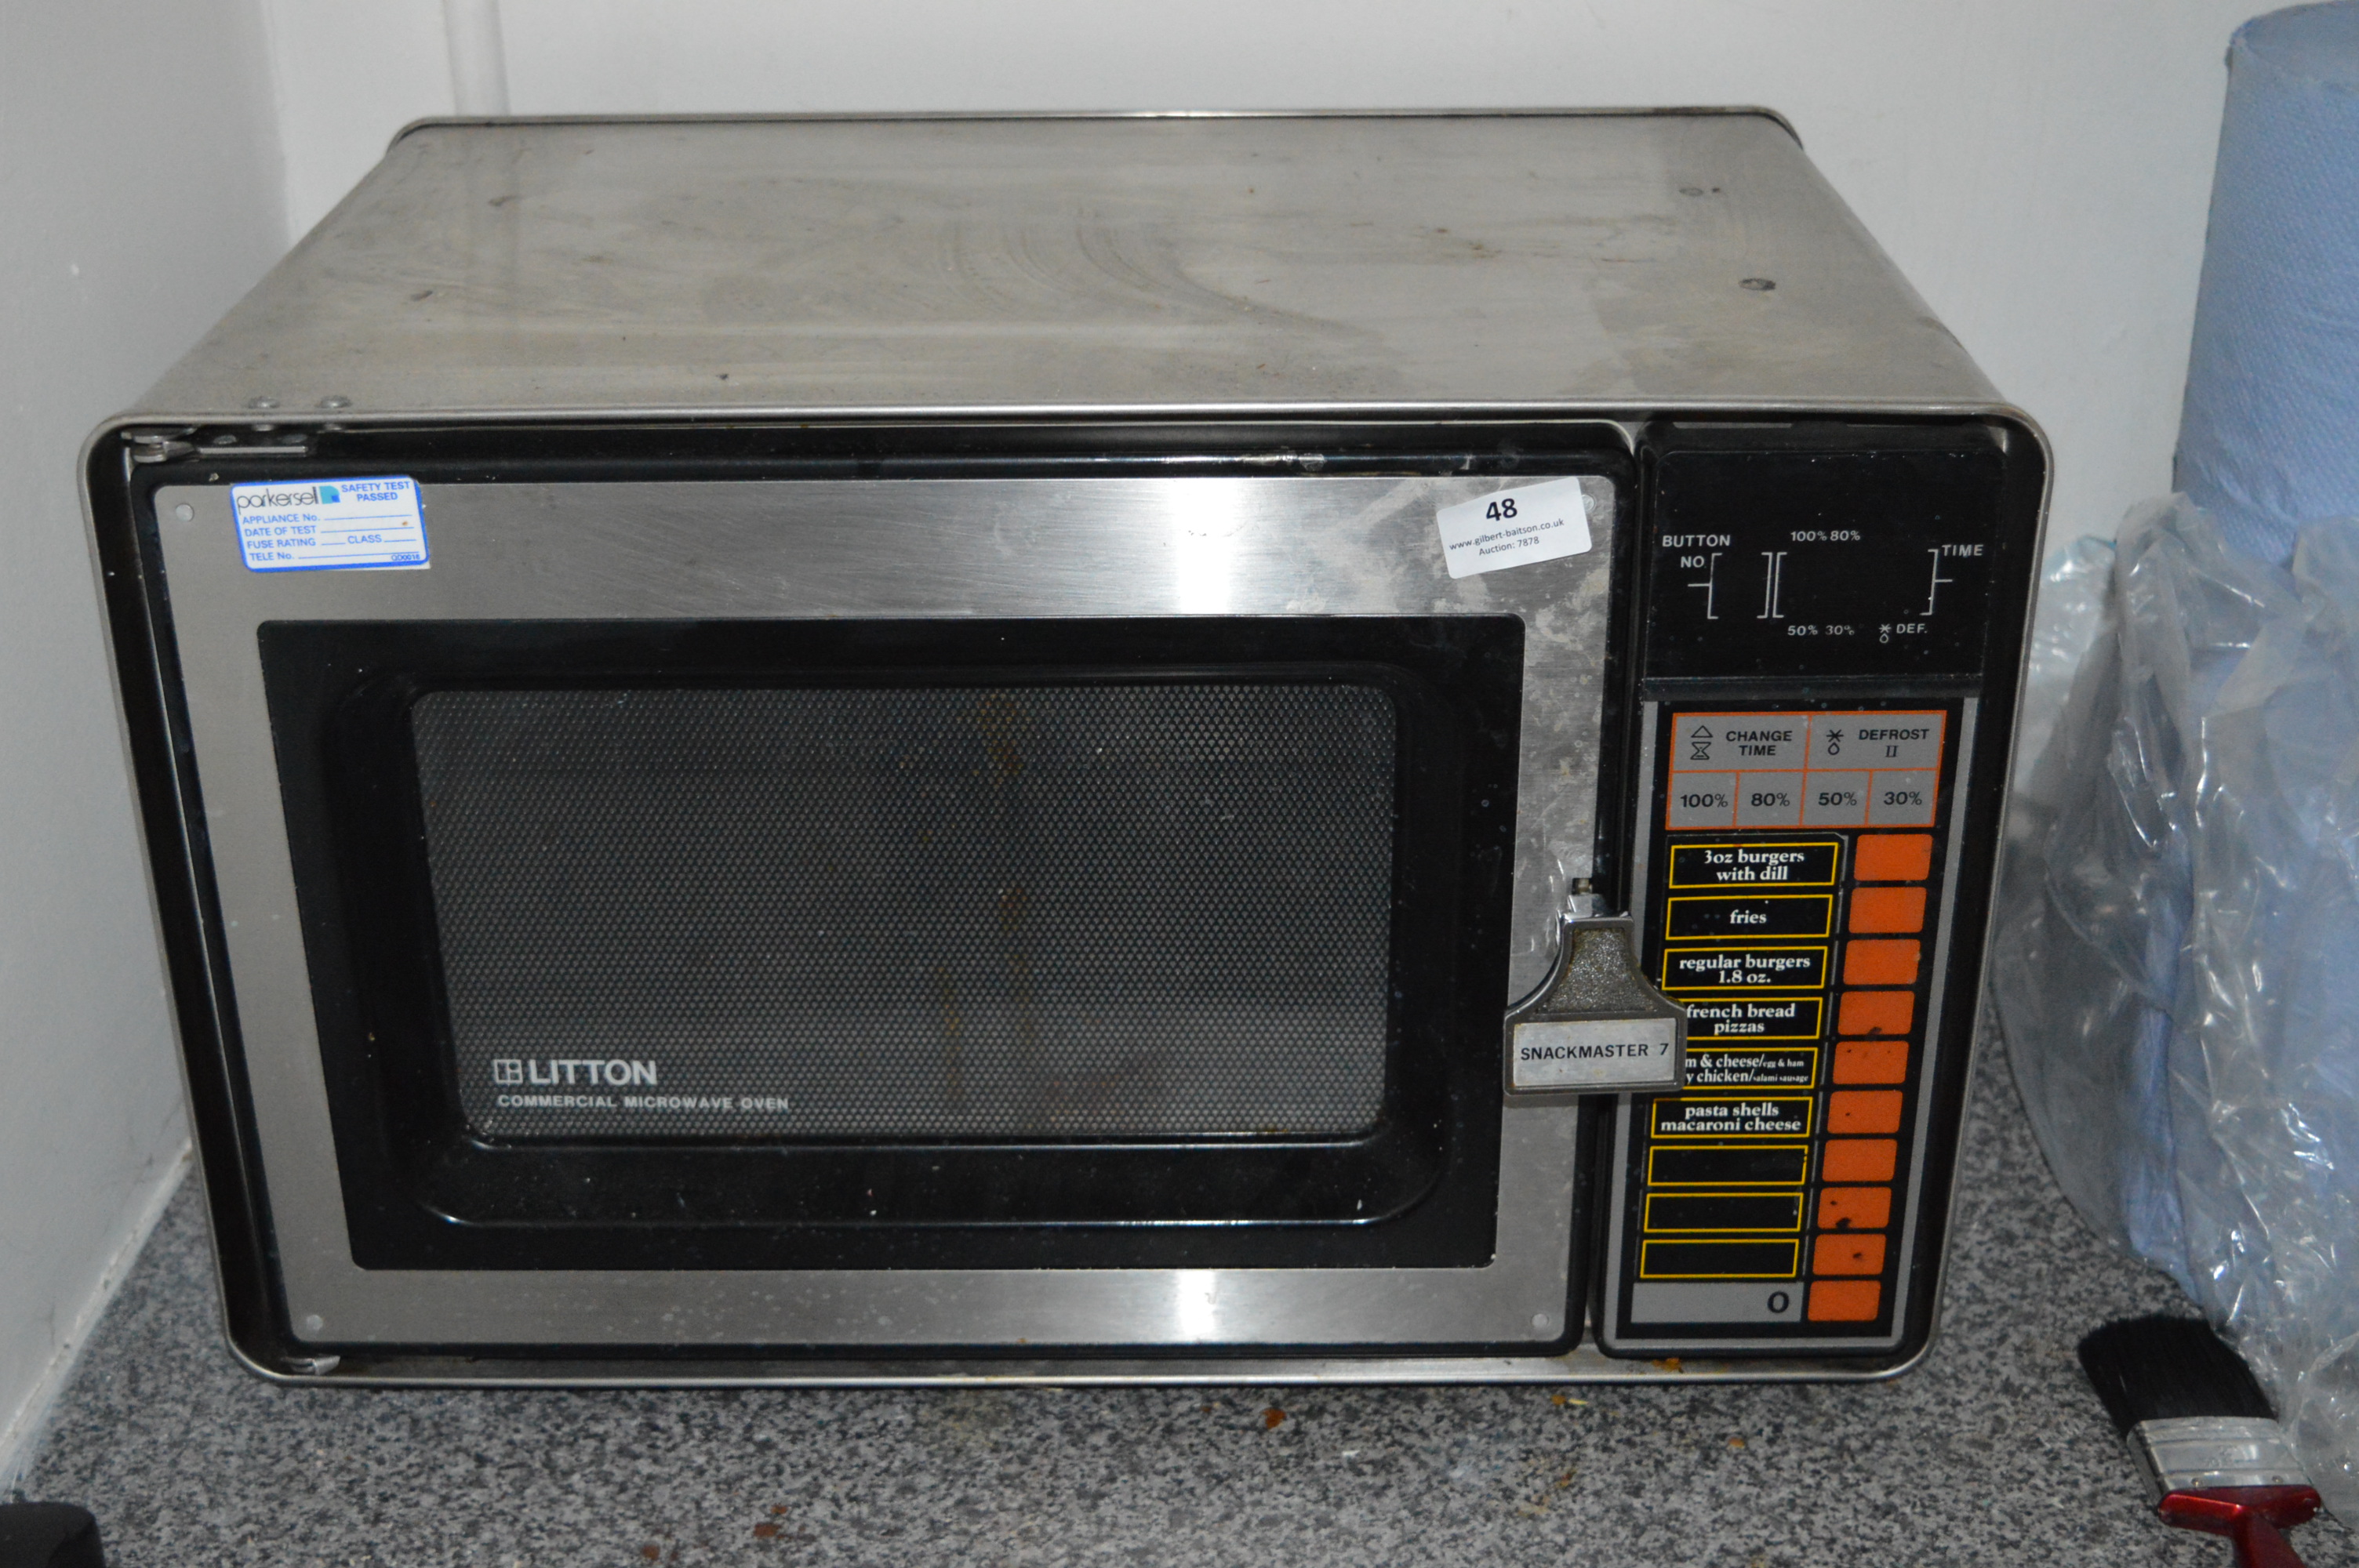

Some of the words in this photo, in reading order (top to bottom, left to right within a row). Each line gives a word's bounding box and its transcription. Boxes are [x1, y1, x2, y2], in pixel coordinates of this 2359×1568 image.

[341, 482, 383, 492] SAFETY
[383, 481, 410, 491] TEST
[357, 492, 398, 502] PASSED
[1485, 498, 1518, 521] 48
[242, 514, 300, 524] APPLIANCE
[303, 513, 321, 521] No.
[245, 527, 271, 537] DATE
[274, 526, 288, 535] OF
[290, 524, 316, 535] TEST
[1449, 518, 1565, 550] www.gilbert-baitson.co.uk
[1790, 531, 1827, 542] 100%
[1830, 530, 1861, 542] 80%
[247, 539, 274, 550] FUSE
[277, 538, 316, 547] RATING
[347, 535, 383, 544] CLASS
[1479, 541, 1516, 556] Auction:
[1518, 536, 1540, 548] 7878
[1662, 534, 1731, 548] BUTTON
[249, 552, 274, 561] TELE
[277, 551, 294, 561] No.
[1941, 544, 1984, 557] TIME
[1787, 625, 1819, 636] 50%
[1825, 625, 1856, 636] 30%
[1896, 623, 1928, 634] DEF.
[1725, 730, 1793, 742] CHANGE
[1859, 728, 1930, 741] DEFROST
[1739, 745, 1776, 757] TIME
[1680, 793, 1728, 808] 100%
[1751, 793, 1790, 808] 80%
[1818, 792, 1858, 807] 50%
[1883, 791, 1923, 806] 30%
[1703, 850, 1733, 864] 3oz
[1737, 848, 1805, 866] burgers
[1716, 866, 1756, 881] with
[1760, 866, 1788, 880] dill
[1729, 909, 1767, 924] fries
[1679, 953, 1742, 972] regular
[1745, 953, 1811, 971] burgers
[1718, 969, 1743, 984] 1.8
[1747, 973, 1772, 984] oz.
[1686, 1003, 1743, 1018] french
[1747, 1003, 1796, 1018] bread
[1714, 1019, 1765, 1036] pizzas
[1521, 1044, 1649, 1061] SNACKMASTER
[1659, 1043, 1670, 1056] 7
[1699, 1054, 1713, 1068] &
[1787, 1058, 1805, 1067] ham
[529, 1059, 658, 1086] LITTON
[1779, 1075, 1809, 1083] sausage
[497, 1094, 617, 1109] COMMERCIAL
[624, 1095, 733, 1109] MICROWAVE
[740, 1096, 790, 1110] OVEN
[1685, 1105, 1728, 1120] pasta
[1732, 1102, 1779, 1116] shells
[1661, 1117, 1741, 1131] macaroni
[1744, 1116, 1801, 1131] cheese
